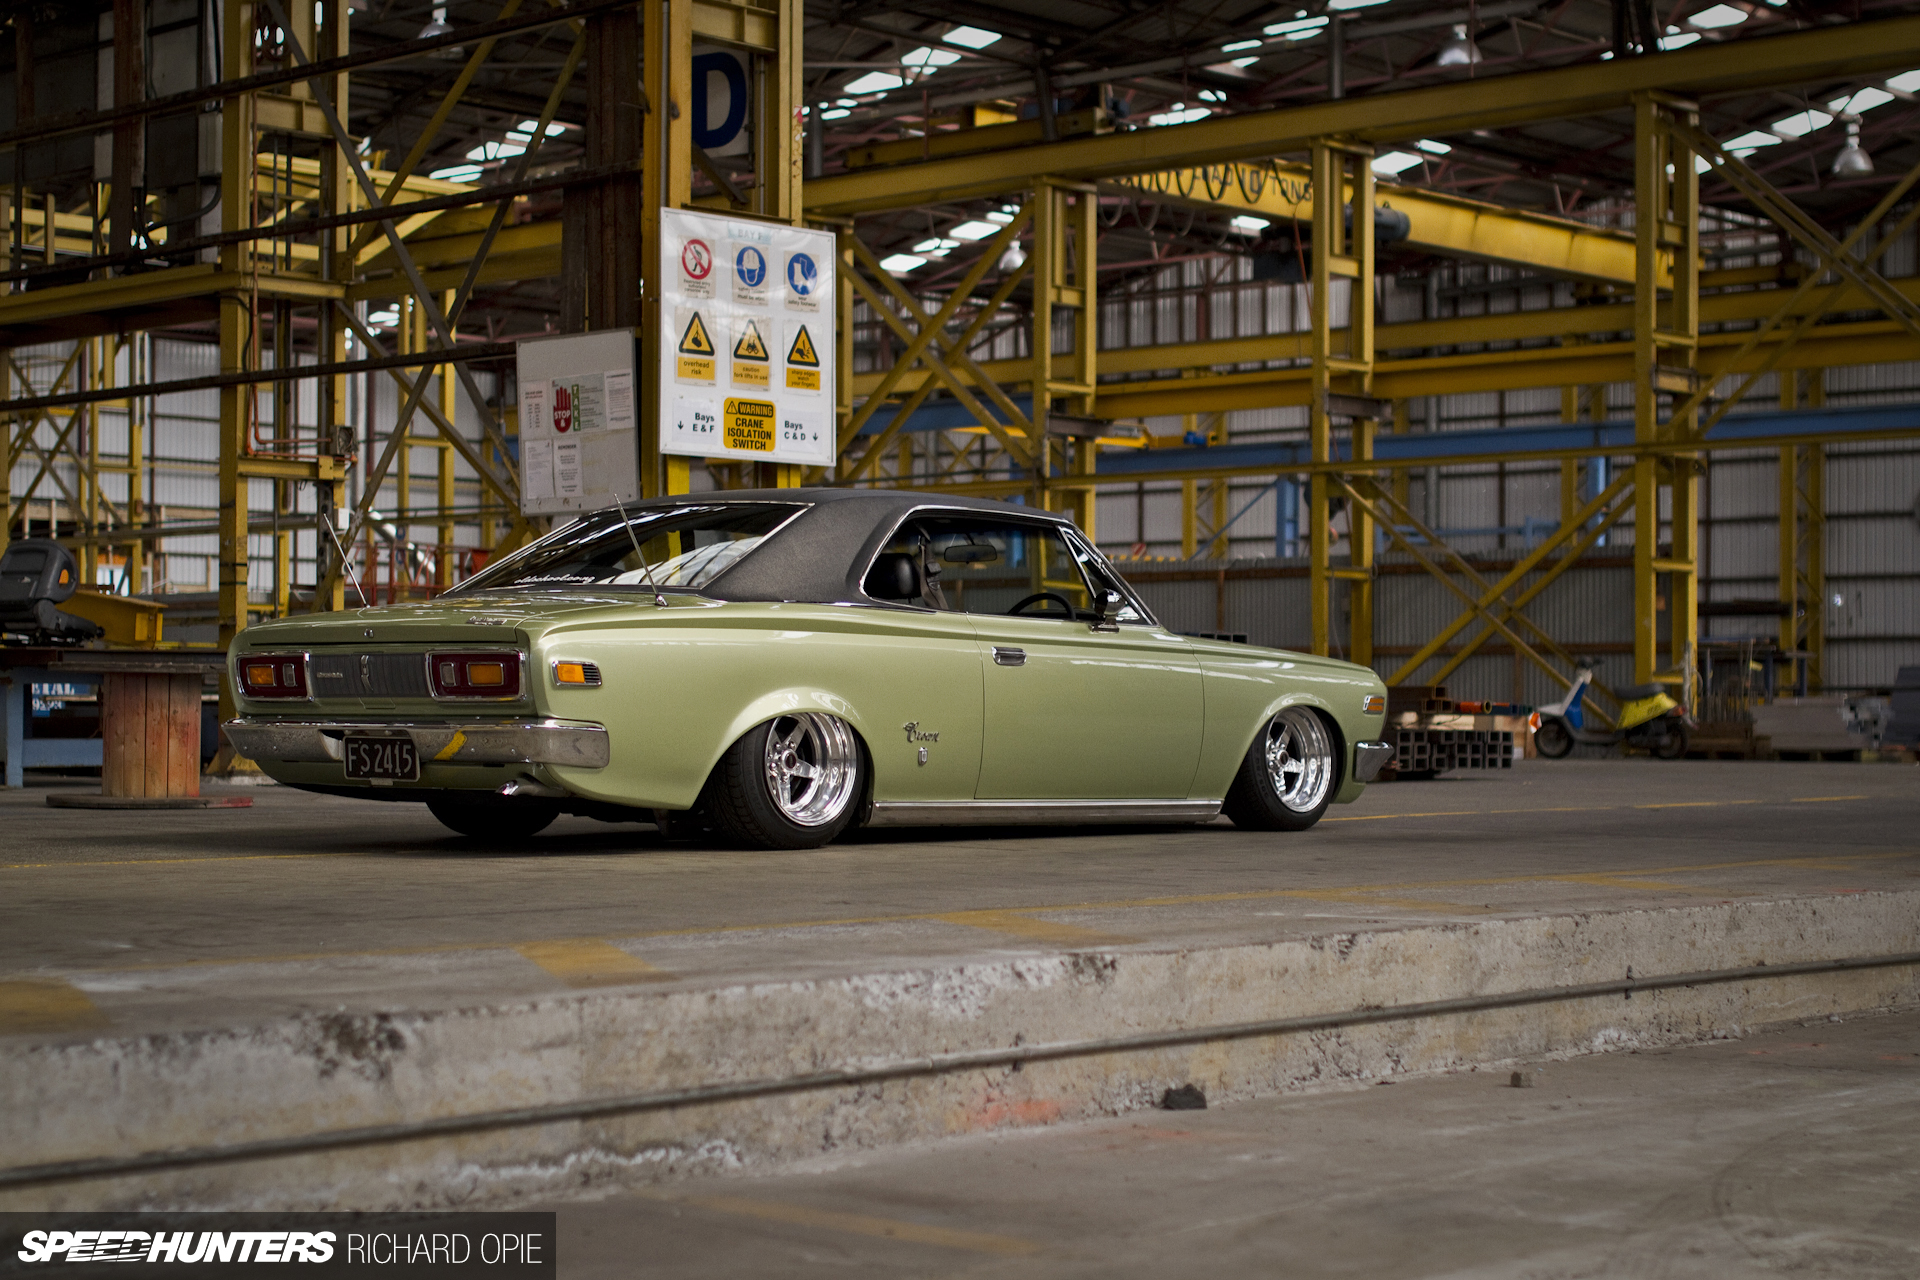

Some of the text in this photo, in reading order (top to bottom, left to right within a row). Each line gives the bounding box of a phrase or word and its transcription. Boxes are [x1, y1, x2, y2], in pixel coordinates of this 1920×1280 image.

[692, 52, 747, 149] D
[683, 360, 710, 368] overhead
[554, 410, 571, 419] STOP
[739, 403, 773, 416] WARNING
[694, 412, 715, 423] Bays
[735, 417, 764, 429] CRANE
[692, 423, 715, 433] E & F
[784, 420, 803, 431] Bays
[727, 427, 772, 440] ISOLATION
[784, 431, 790, 439] C
[792, 432, 798, 440] &
[732, 438, 766, 450] SWITCH
[348, 743, 412, 774] FS2415
